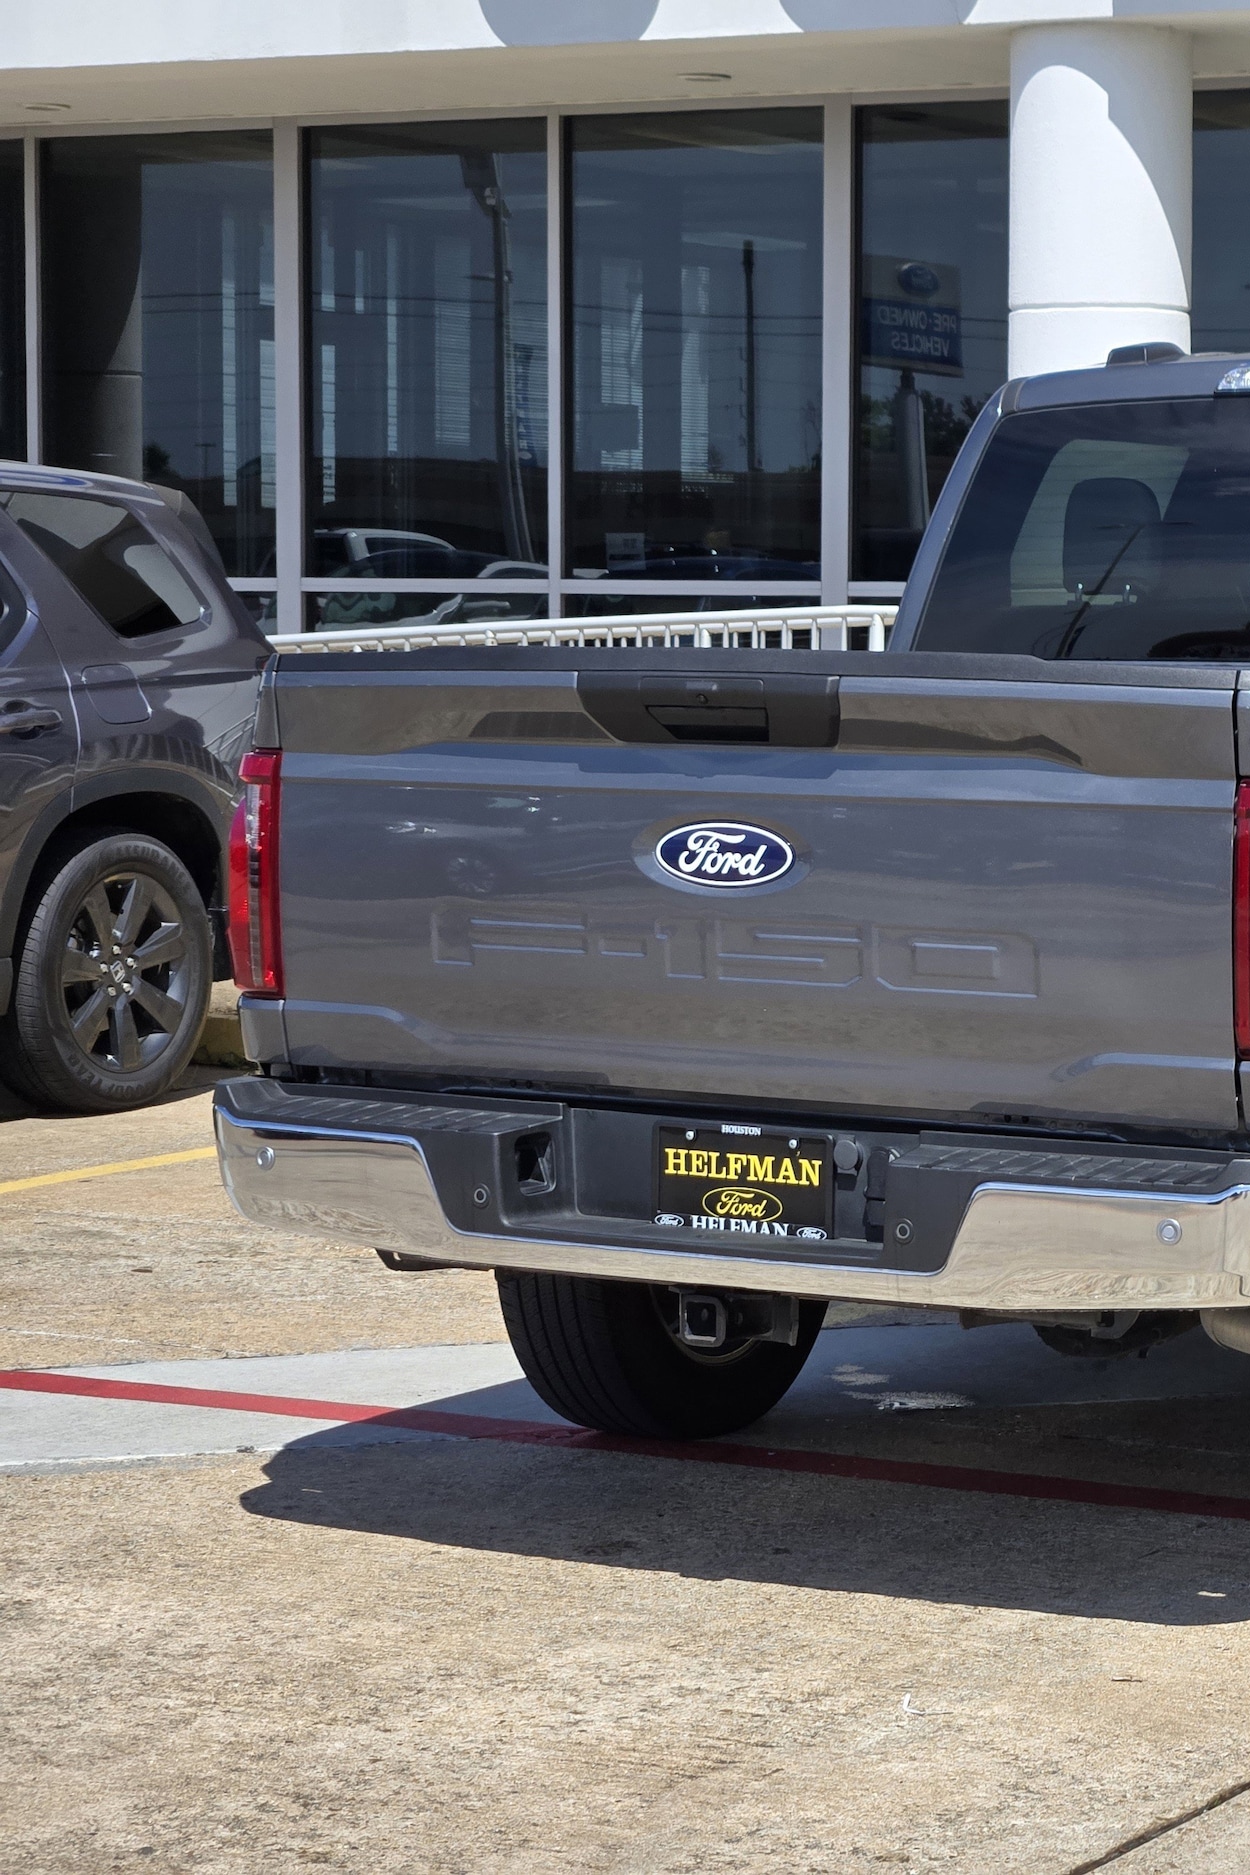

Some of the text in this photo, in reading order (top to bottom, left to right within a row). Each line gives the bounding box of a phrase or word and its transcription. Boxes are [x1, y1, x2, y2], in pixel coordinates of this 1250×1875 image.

[679, 829, 770, 876] Ford
[430, 910, 1040, 1000] F-150
[721, 1124, 762, 1136] HOUSTON
[664, 1148, 822, 1187] HELFMAN
[715, 1190, 767, 1218] Ford
